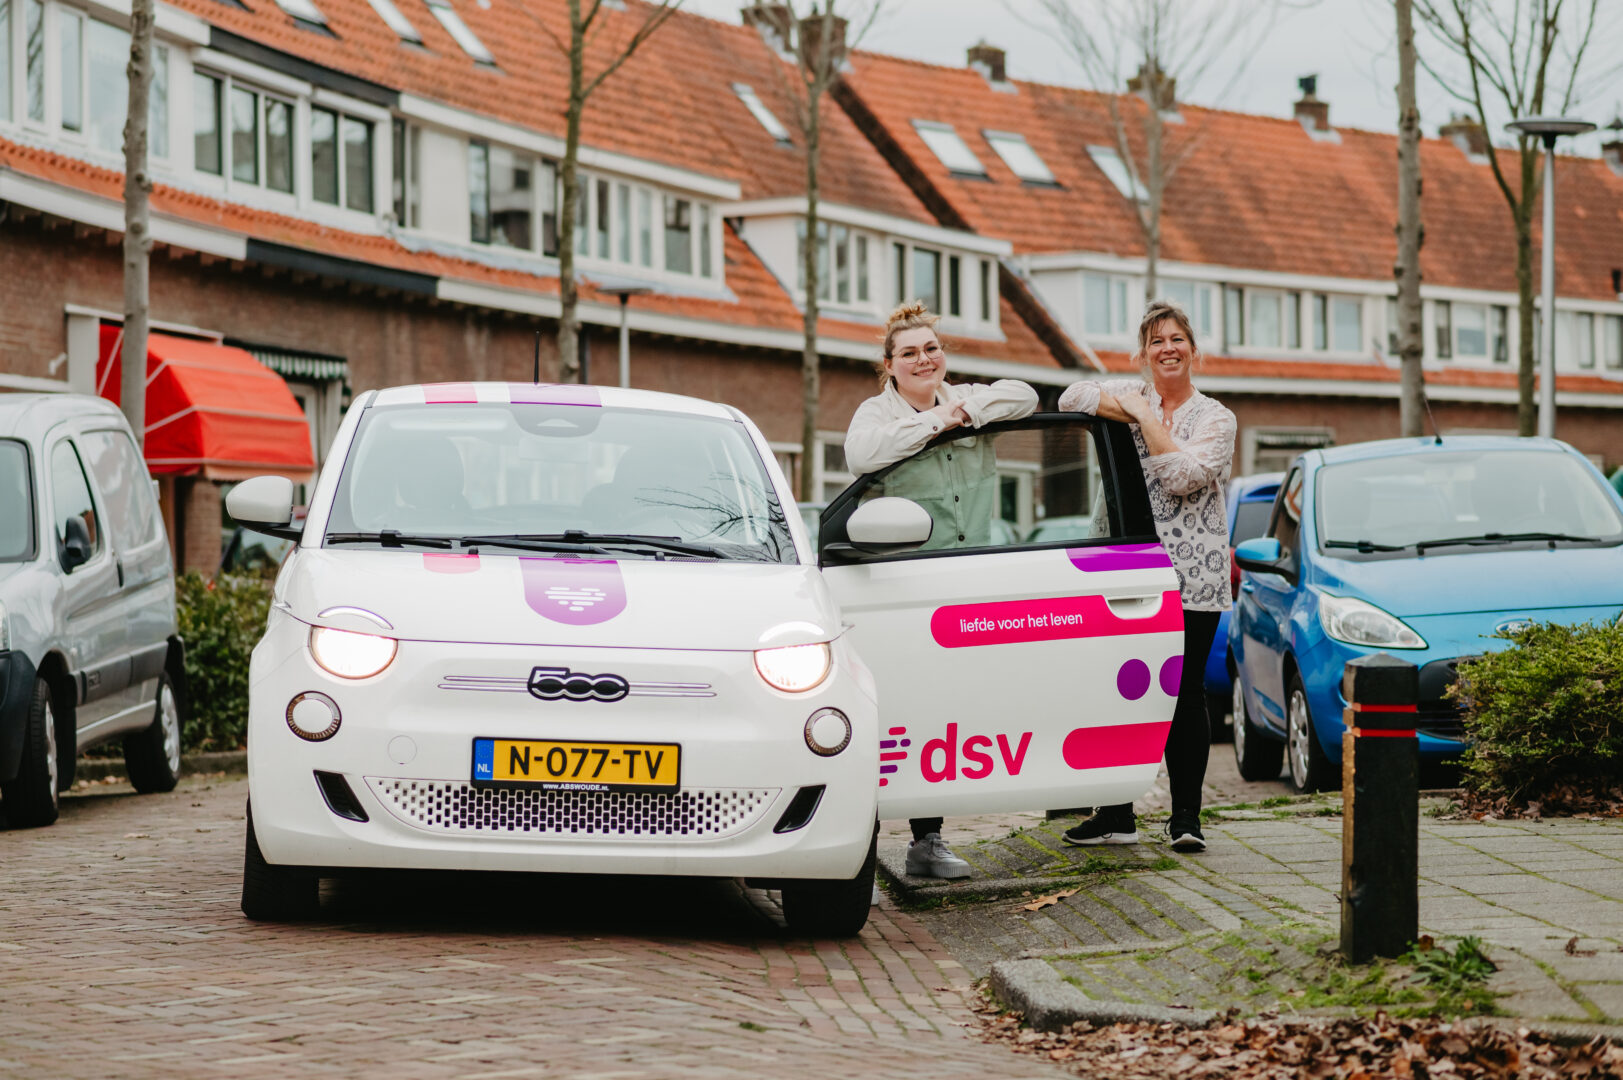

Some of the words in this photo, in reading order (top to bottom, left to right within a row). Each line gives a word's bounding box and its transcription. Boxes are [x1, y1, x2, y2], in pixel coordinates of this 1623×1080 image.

[960, 618, 995, 633] liefde
[997, 619, 1025, 630] voor
[1027, 613, 1048, 628] het
[1050, 612, 1083, 627] leven
[527, 666, 630, 703] 500
[477, 763, 491, 773] NL
[509, 745, 664, 780] N-077-TV
[920, 722, 1033, 783] dsv
